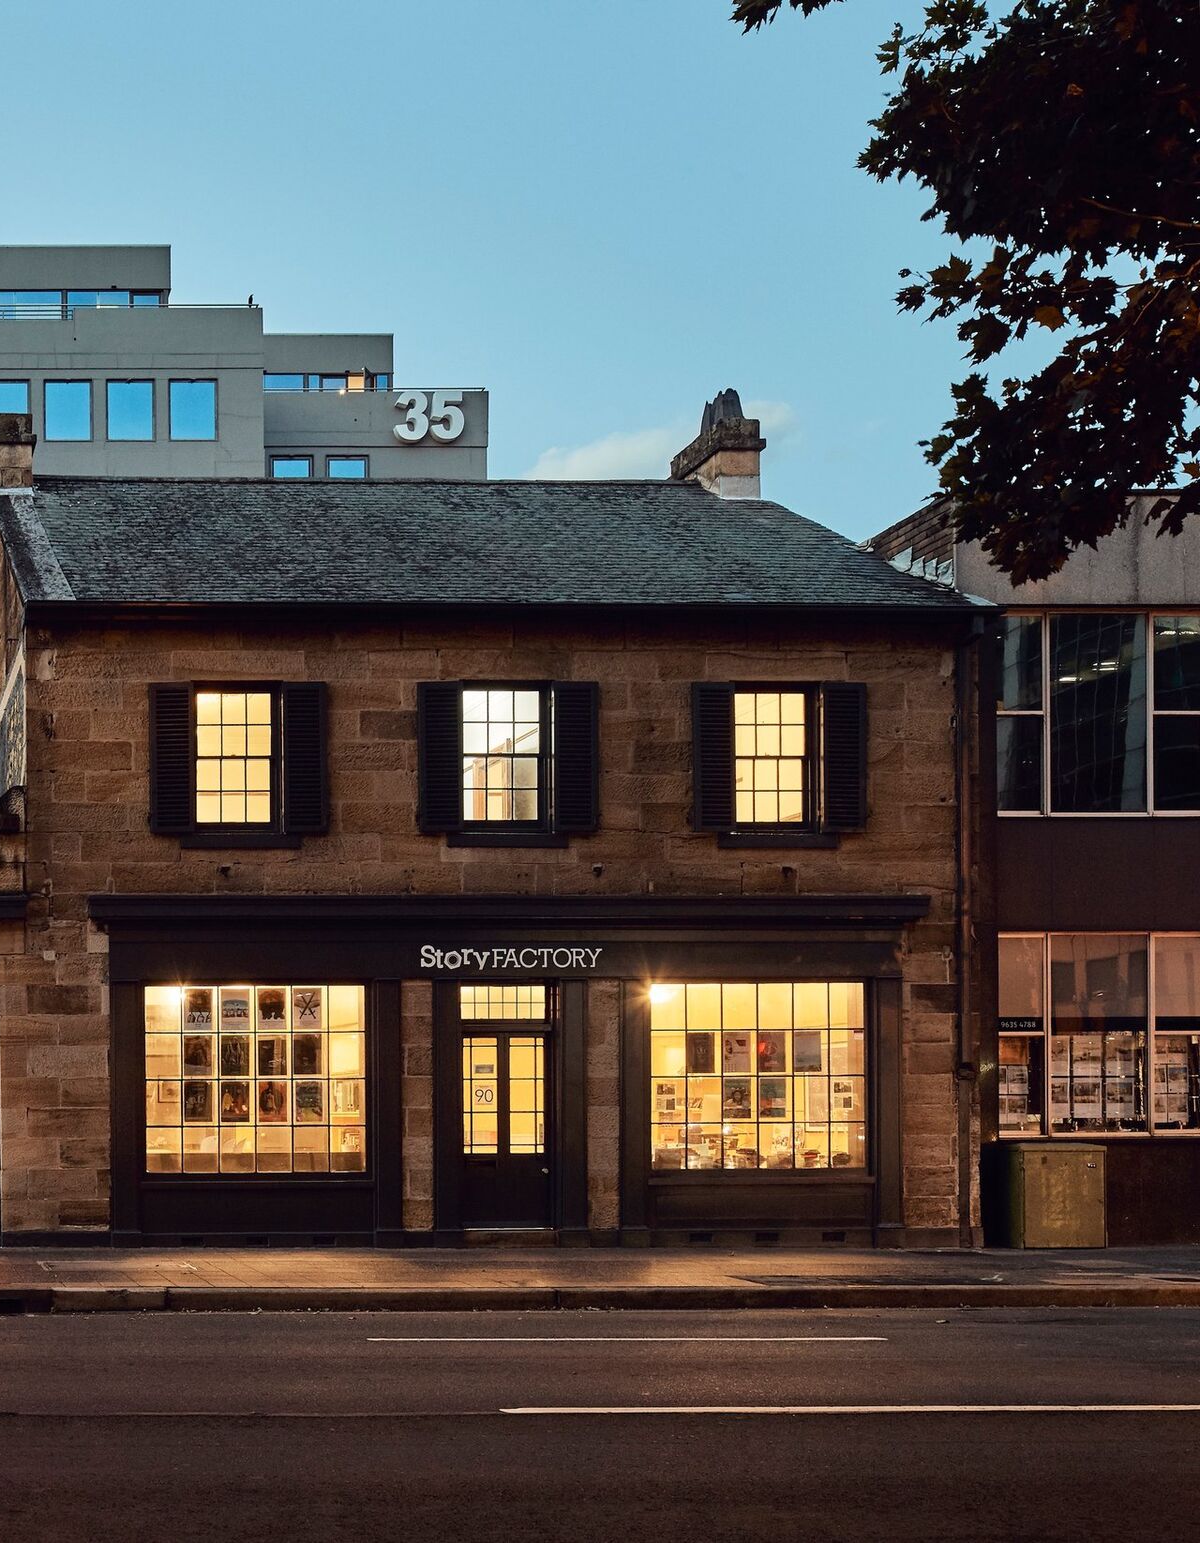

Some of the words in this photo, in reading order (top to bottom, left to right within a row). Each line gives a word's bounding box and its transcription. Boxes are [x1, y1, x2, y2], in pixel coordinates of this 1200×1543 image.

[393, 391, 465, 444] 35
[491, 947, 603, 969] FACTORY
[475, 1089, 494, 1103] 90
